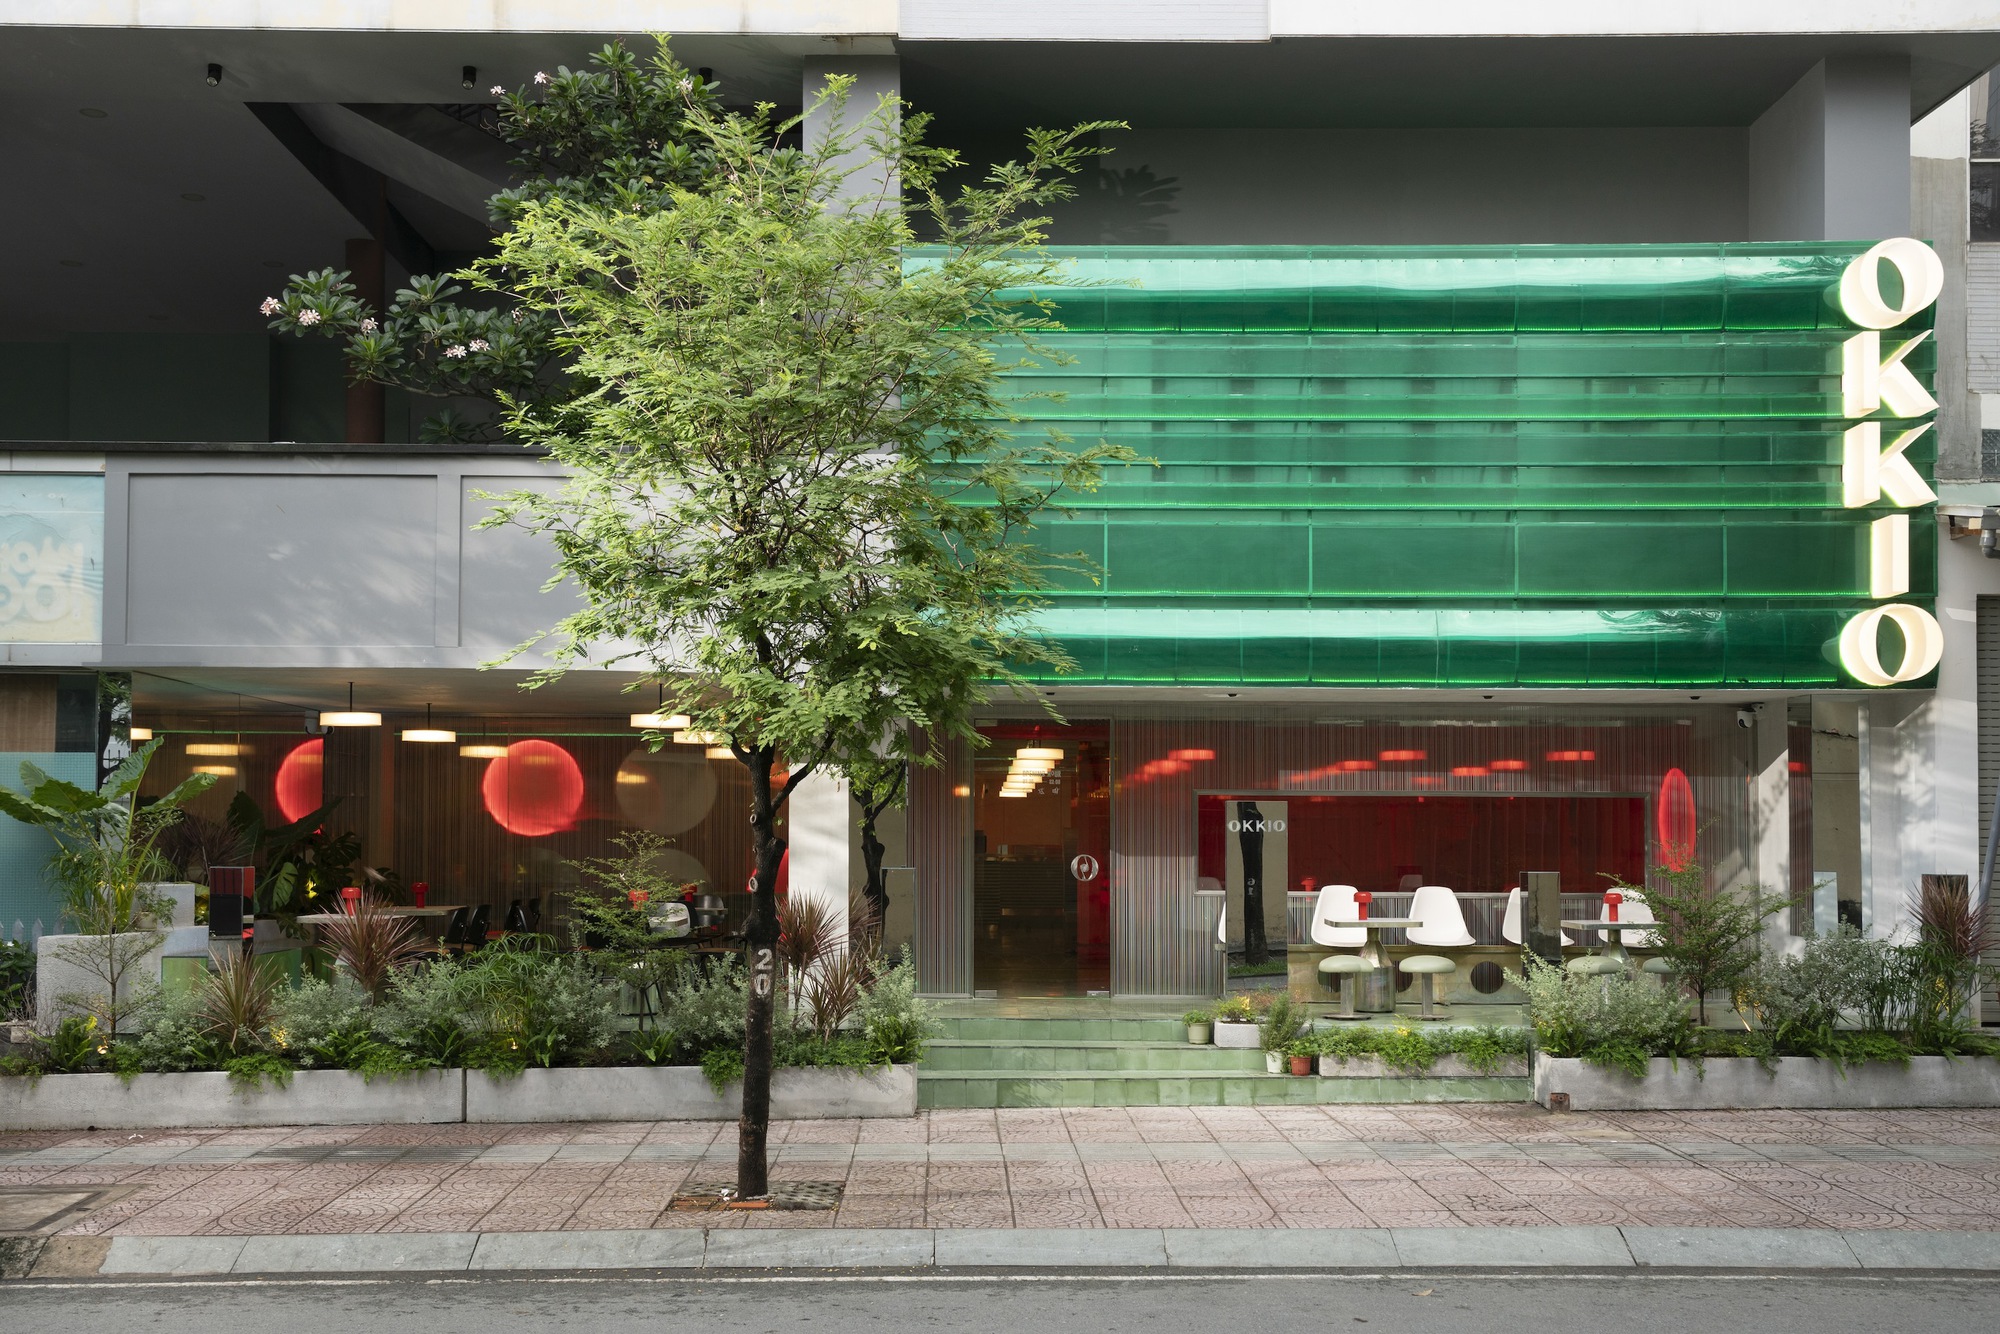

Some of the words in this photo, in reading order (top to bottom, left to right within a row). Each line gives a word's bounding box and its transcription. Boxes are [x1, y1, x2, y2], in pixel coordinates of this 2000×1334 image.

[1839, 237, 1944, 687] OKKIO
[1228, 820, 1286, 832] OKKIO
[755, 948, 773, 996] 20
